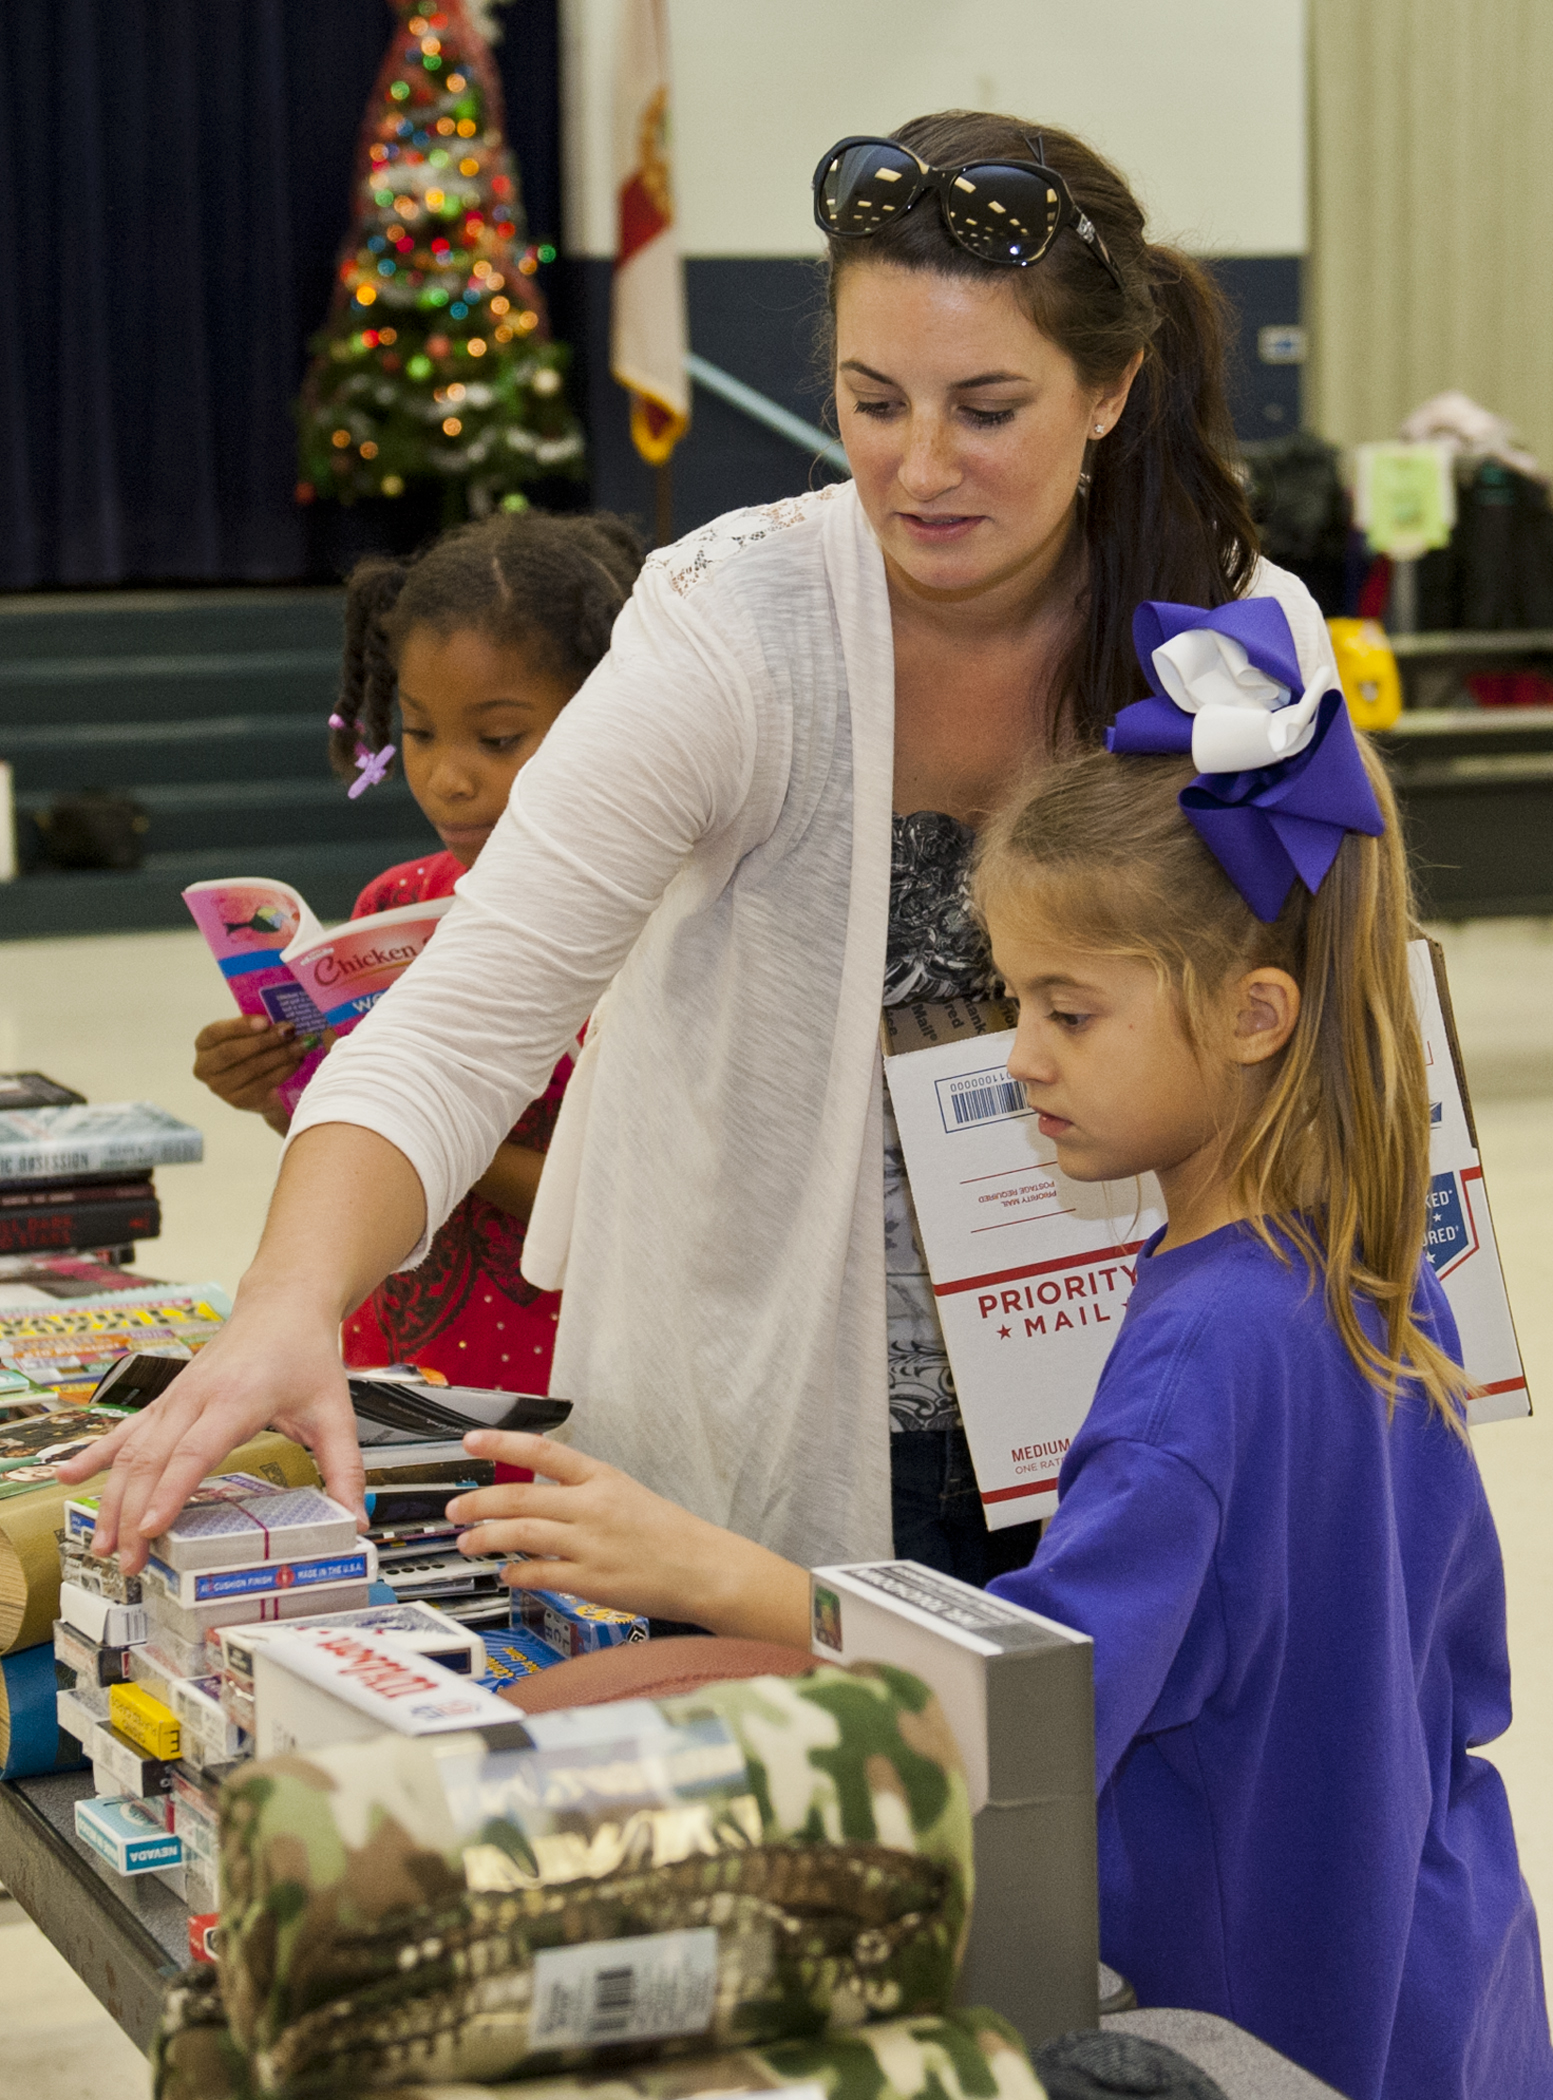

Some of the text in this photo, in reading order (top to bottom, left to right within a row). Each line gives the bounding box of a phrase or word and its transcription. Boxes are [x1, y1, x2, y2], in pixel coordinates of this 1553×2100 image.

[314, 944, 418, 986] Chicken
[978, 1180, 1055, 1204] POSTAGE REQUIRED
[1001, 1190, 1057, 1208] PRIORITY MAIL
[978, 1265, 1137, 1320] PRIORITY
[1024, 1303, 1111, 1338] MAIL
[1011, 1438, 1071, 1462] MEDIUM
[1015, 1462, 1038, 1475] ONE
[298, 1568, 318, 1579] MADE
[319, 1567, 327, 1577] IN
[328, 1565, 342, 1575] THE
[214, 1579, 247, 1592] CUSHION
[248, 1575, 273, 1587] FINISH
[130, 1844, 178, 1863] NEVADA
